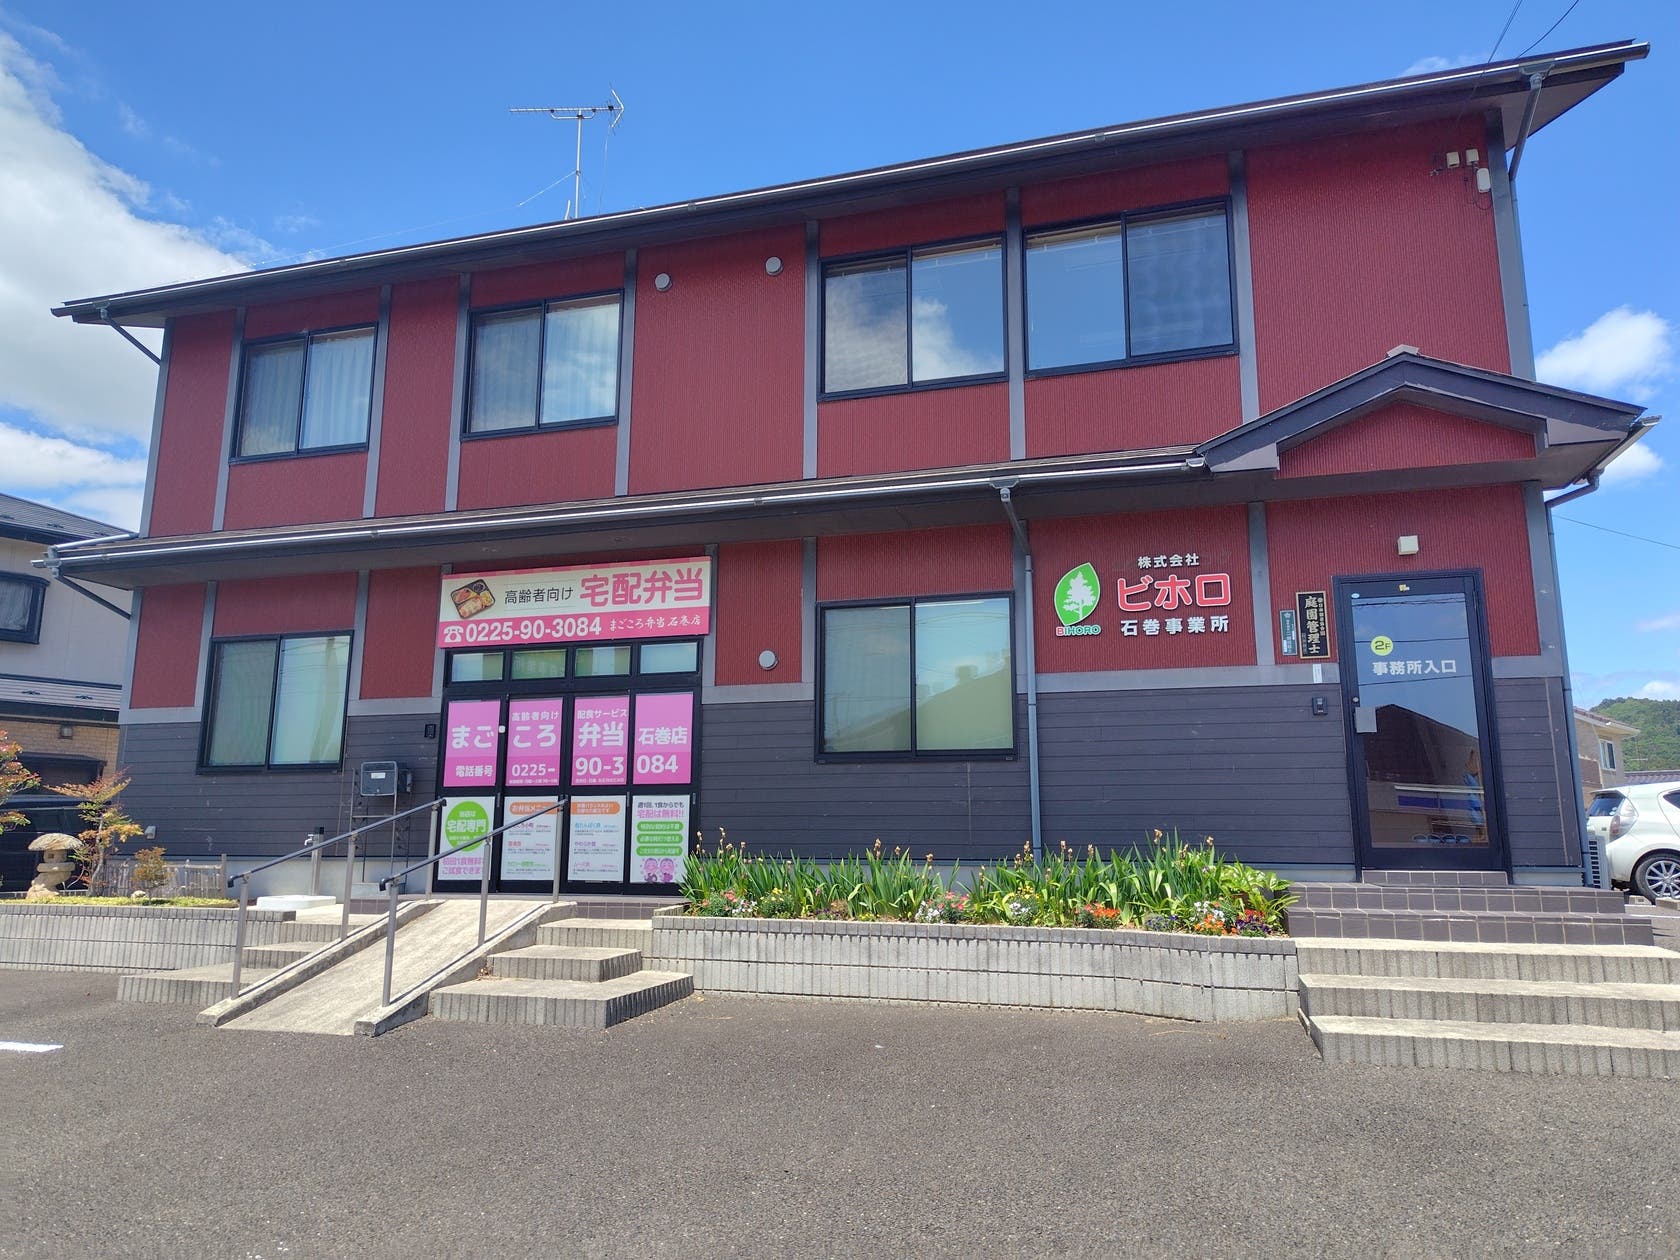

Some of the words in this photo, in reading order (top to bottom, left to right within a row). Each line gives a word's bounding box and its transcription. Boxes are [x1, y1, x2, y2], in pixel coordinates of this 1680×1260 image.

[1137, 553, 1200, 569] 株式会社
[504, 586, 574, 605] 高齢者向け
[580, 567, 703, 607] 宅配弁当
[1117, 573, 1231, 612] ビホロ
[465, 616, 602, 643] 0225-90-3084
[1056, 624, 1101, 636] BIHORO
[1120, 615, 1229, 636] 石巻事業所
[1374, 640, 1391, 651] 2F
[1372, 659, 1457, 676] 事務所入口
[511, 710, 560, 722] 高齢者向け
[451, 725, 494, 749] まご
[512, 724, 557, 749] ころ
[578, 720, 625, 748] 弁当
[638, 726, 688, 746] 石巻店
[455, 765, 493, 777] 電話番号
[575, 756, 624, 775] 90-3
[636, 754, 679, 774] 084
[447, 819, 487, 833] 宅配専門
